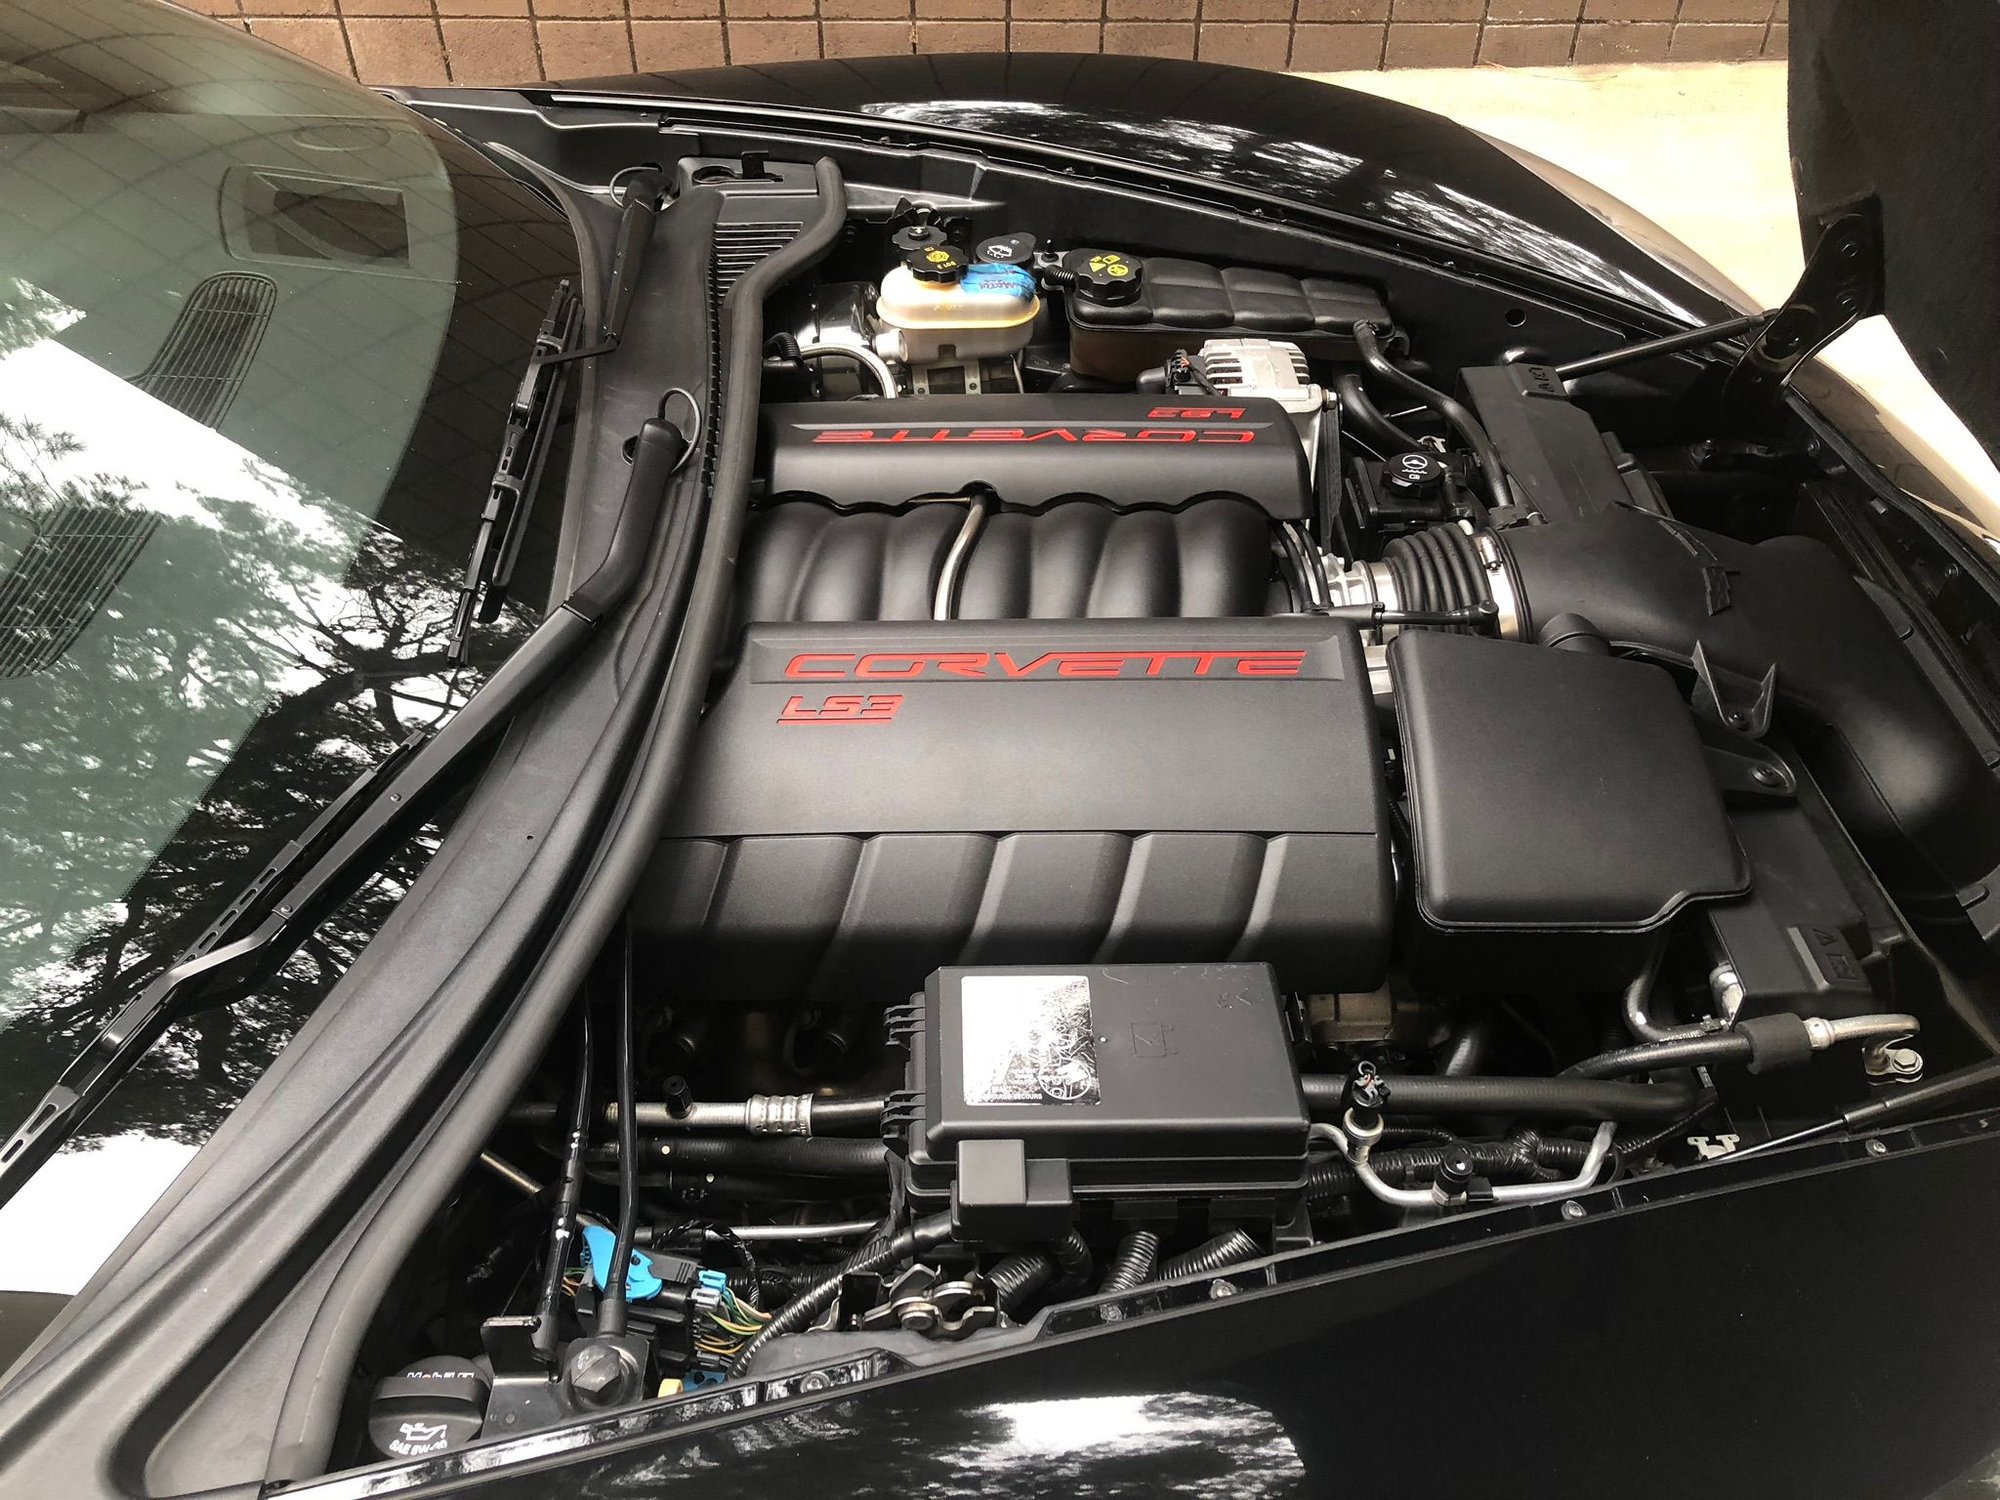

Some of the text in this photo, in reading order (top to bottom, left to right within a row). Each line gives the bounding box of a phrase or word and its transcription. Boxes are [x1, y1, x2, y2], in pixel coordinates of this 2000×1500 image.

[1147, 407, 1247, 419] LS3
[811, 430, 1256, 443] CORVETTE
[785, 652, 1306, 678] CORVETTE
[778, 695, 904, 723] LS3
[389, 1439, 411, 1455] SAE
